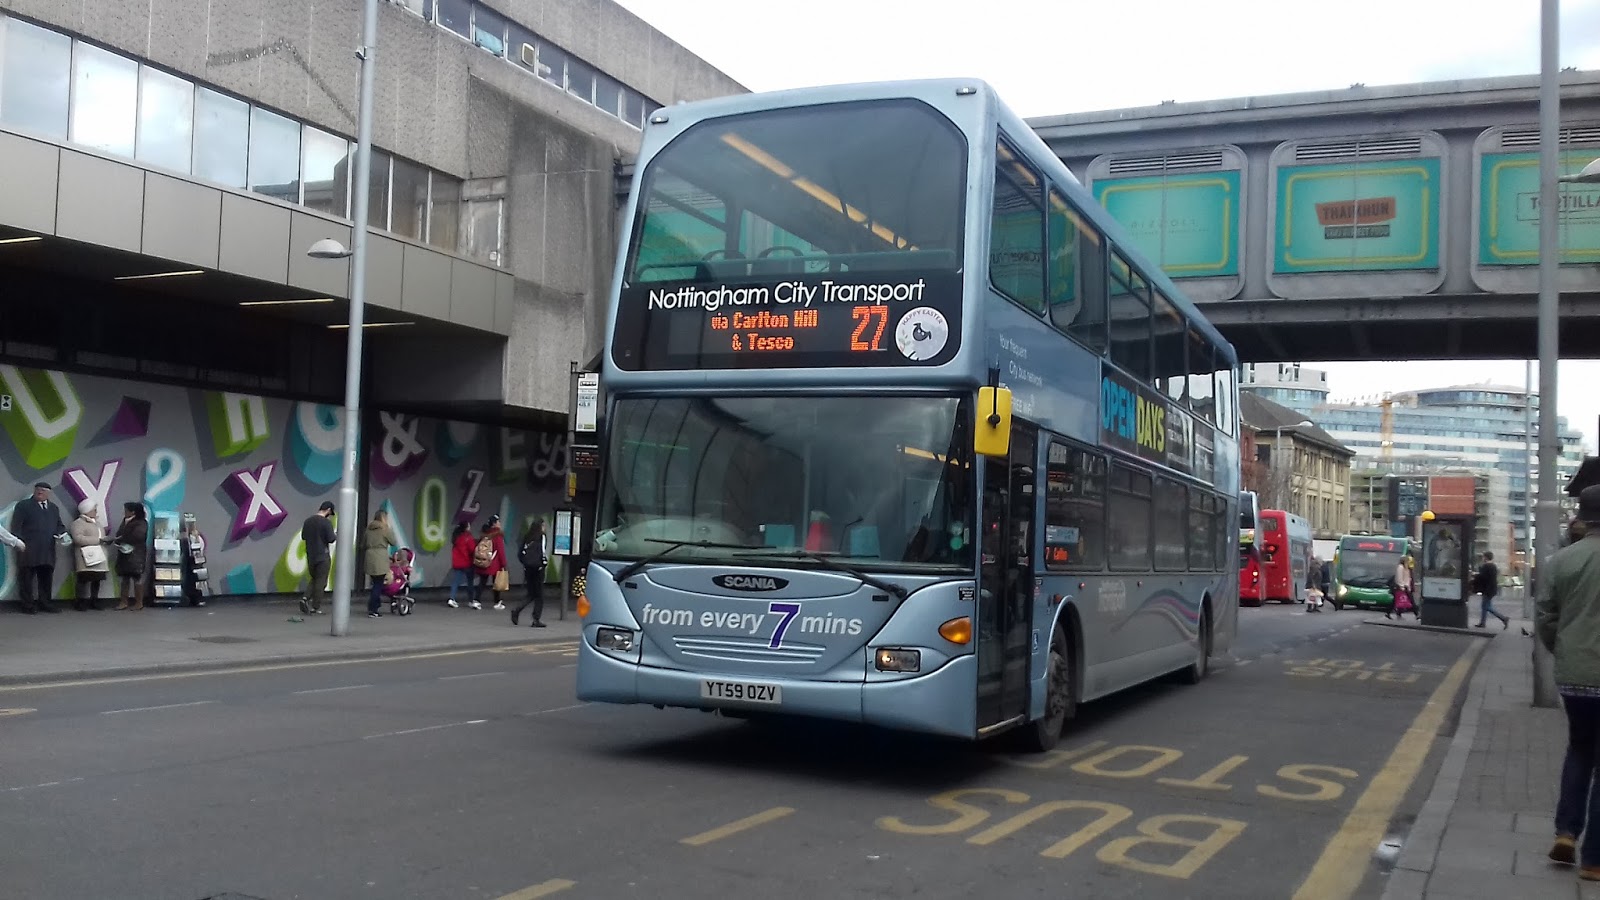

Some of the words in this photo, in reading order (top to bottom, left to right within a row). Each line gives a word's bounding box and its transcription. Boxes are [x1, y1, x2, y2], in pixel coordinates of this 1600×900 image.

[648, 285, 768, 311] Nottingham
[774, 281, 817, 308] City
[821, 278, 926, 305] Transport
[711, 315, 729, 329] via
[733, 311, 789, 329] Carlton
[793, 309, 817, 327] Hill
[850, 305, 888, 351] 27
[901, 310, 921, 326] HAPPY
[922, 309, 944, 325] EASTER
[731, 336, 742, 351] &
[747, 333, 795, 350] Tesco
[1101, 376, 1136, 442] OPEN
[1137, 395, 1165, 453] DAYS
[237, 464, 283, 525] X
[423, 478, 447, 541] Q
[723, 575, 777, 590] SCANIA
[642, 603, 693, 626] from
[700, 610, 764, 634] every
[767, 602, 802, 650] 7
[800, 613, 863, 635] mins
[706, 681, 744, 700] YT59
[747, 684, 777, 702] OZV
[877, 788, 1248, 879] BUS
